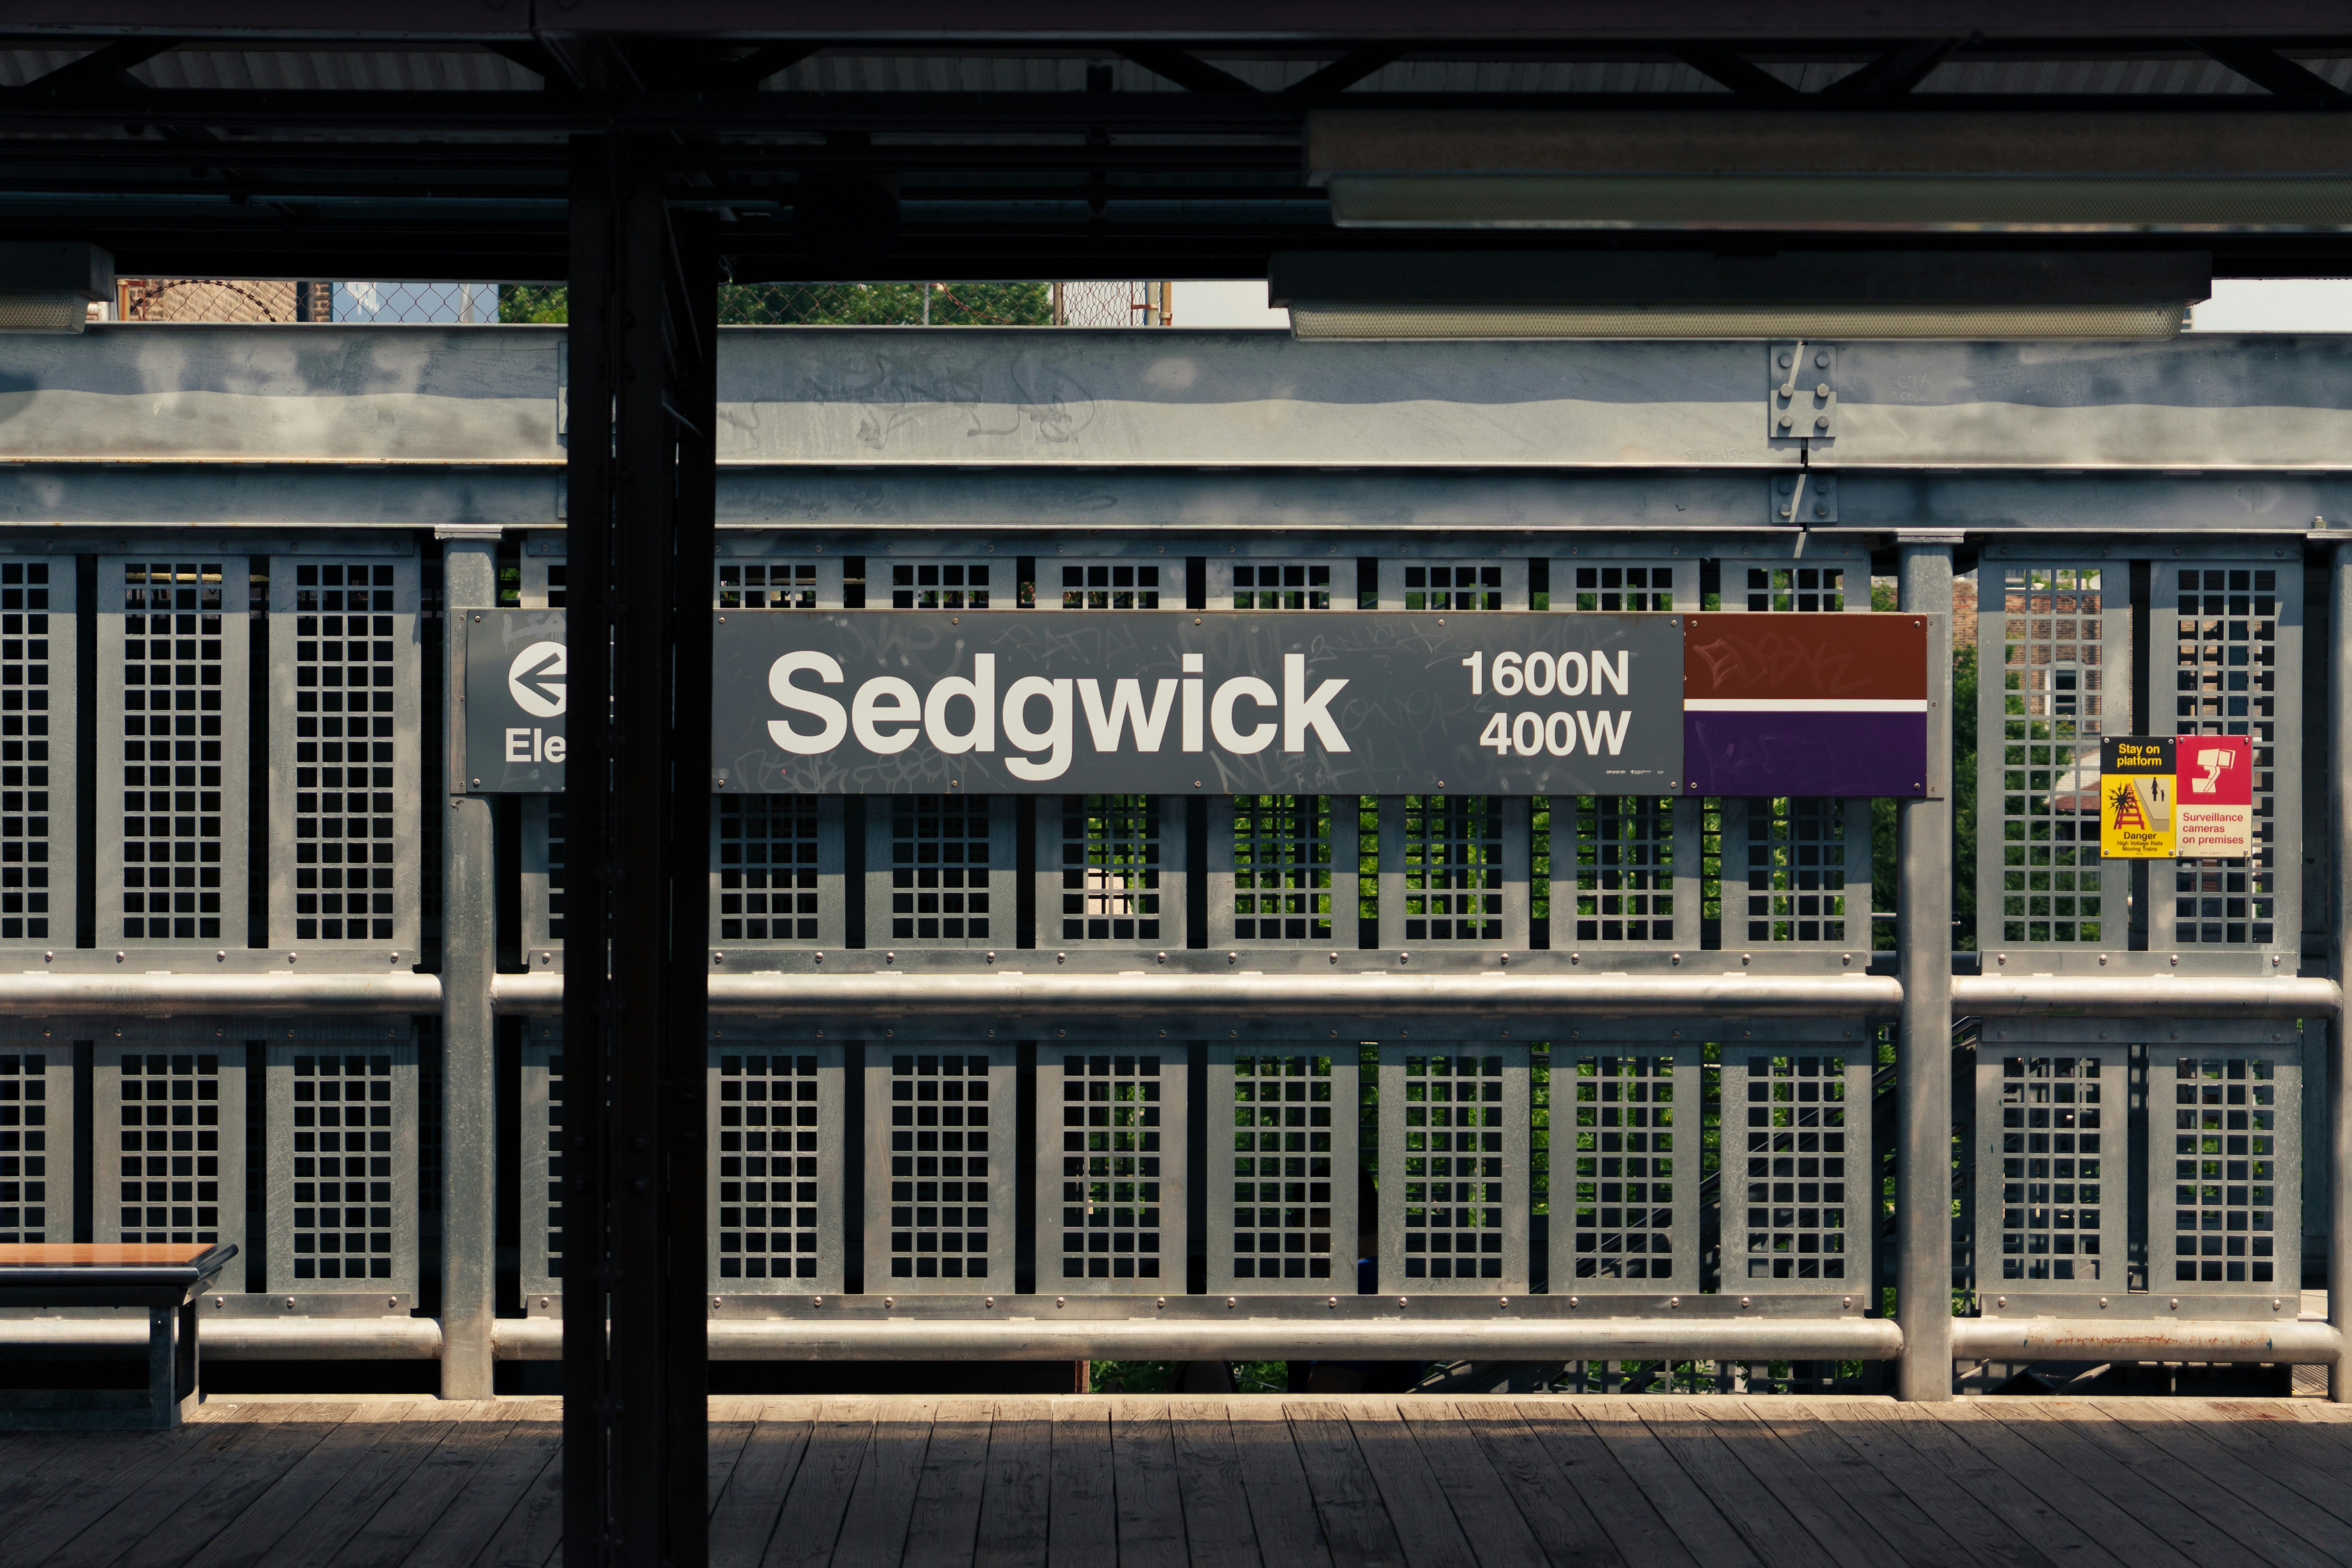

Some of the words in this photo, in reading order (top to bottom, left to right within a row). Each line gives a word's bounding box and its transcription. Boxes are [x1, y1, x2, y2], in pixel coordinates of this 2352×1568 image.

[1897, 372, 1931, 388] CTA
[1463, 650, 1628, 696] 1600N
[767, 651, 1351, 781] Sedgwick
[1480, 711, 1632, 756] 400W
[506, 728, 566, 762] Ele
[2119, 743, 2142, 755] Stay
[2146, 746, 2160, 754] on
[2117, 756, 2162, 767] platform
[2183, 812, 2243, 822] Surveillance
[2124, 831, 2157, 841] Danger
[2198, 836, 2244, 846] premises
